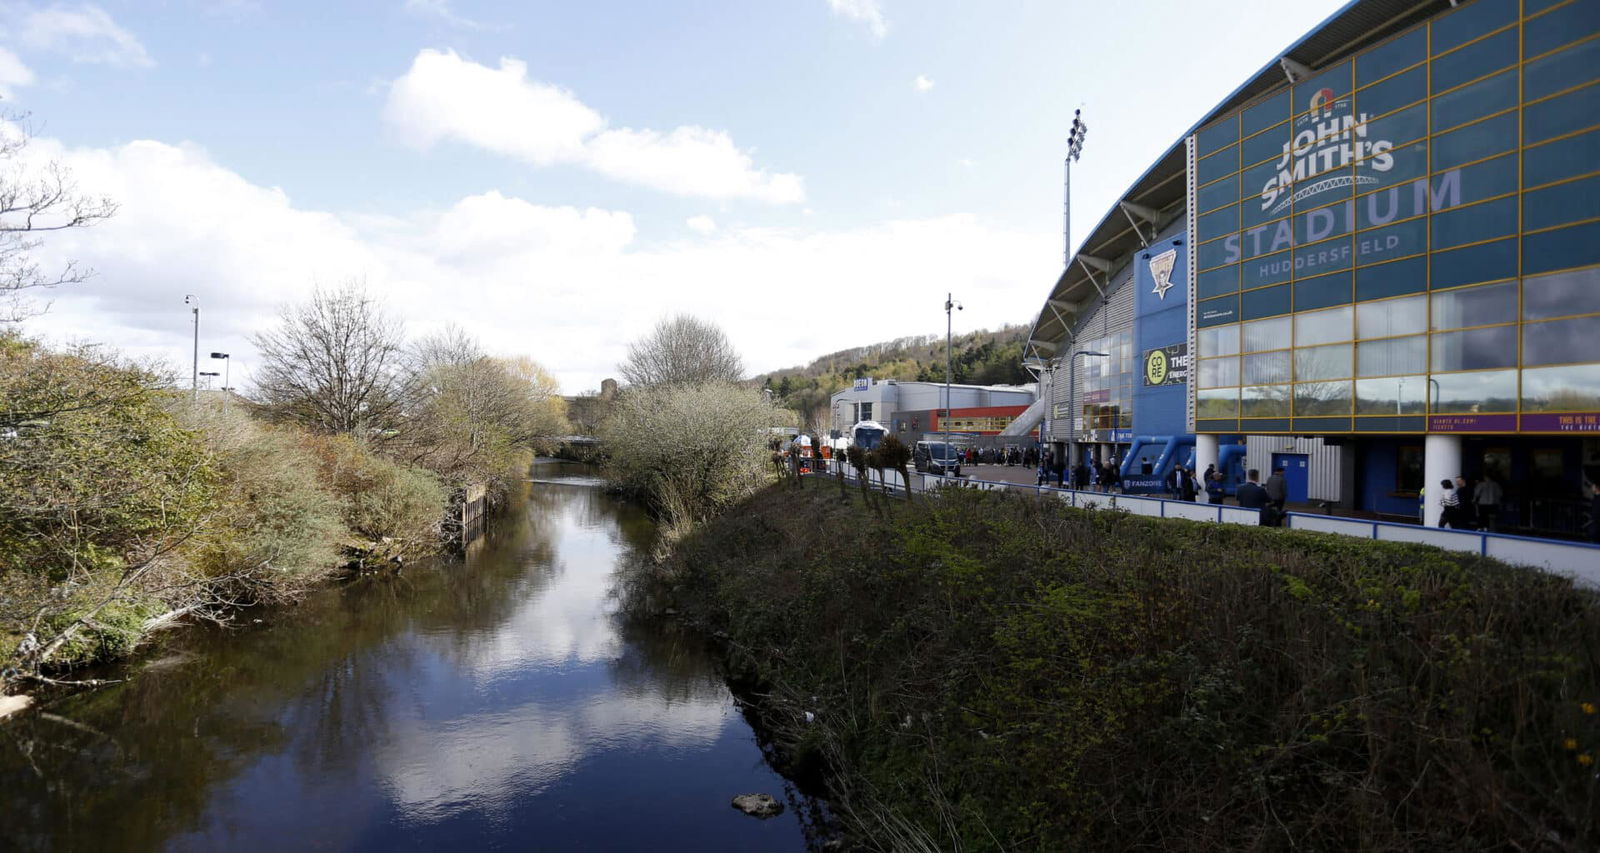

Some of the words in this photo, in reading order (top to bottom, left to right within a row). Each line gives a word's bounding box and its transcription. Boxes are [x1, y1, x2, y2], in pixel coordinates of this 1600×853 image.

[1276, 113, 1367, 170] JOHN
[1261, 140, 1394, 211] SMITH'S
[1224, 168, 1461, 264] STADIUM
[1259, 235, 1399, 278] HUDDERSFELD
[1170, 355, 1189, 368] THE
